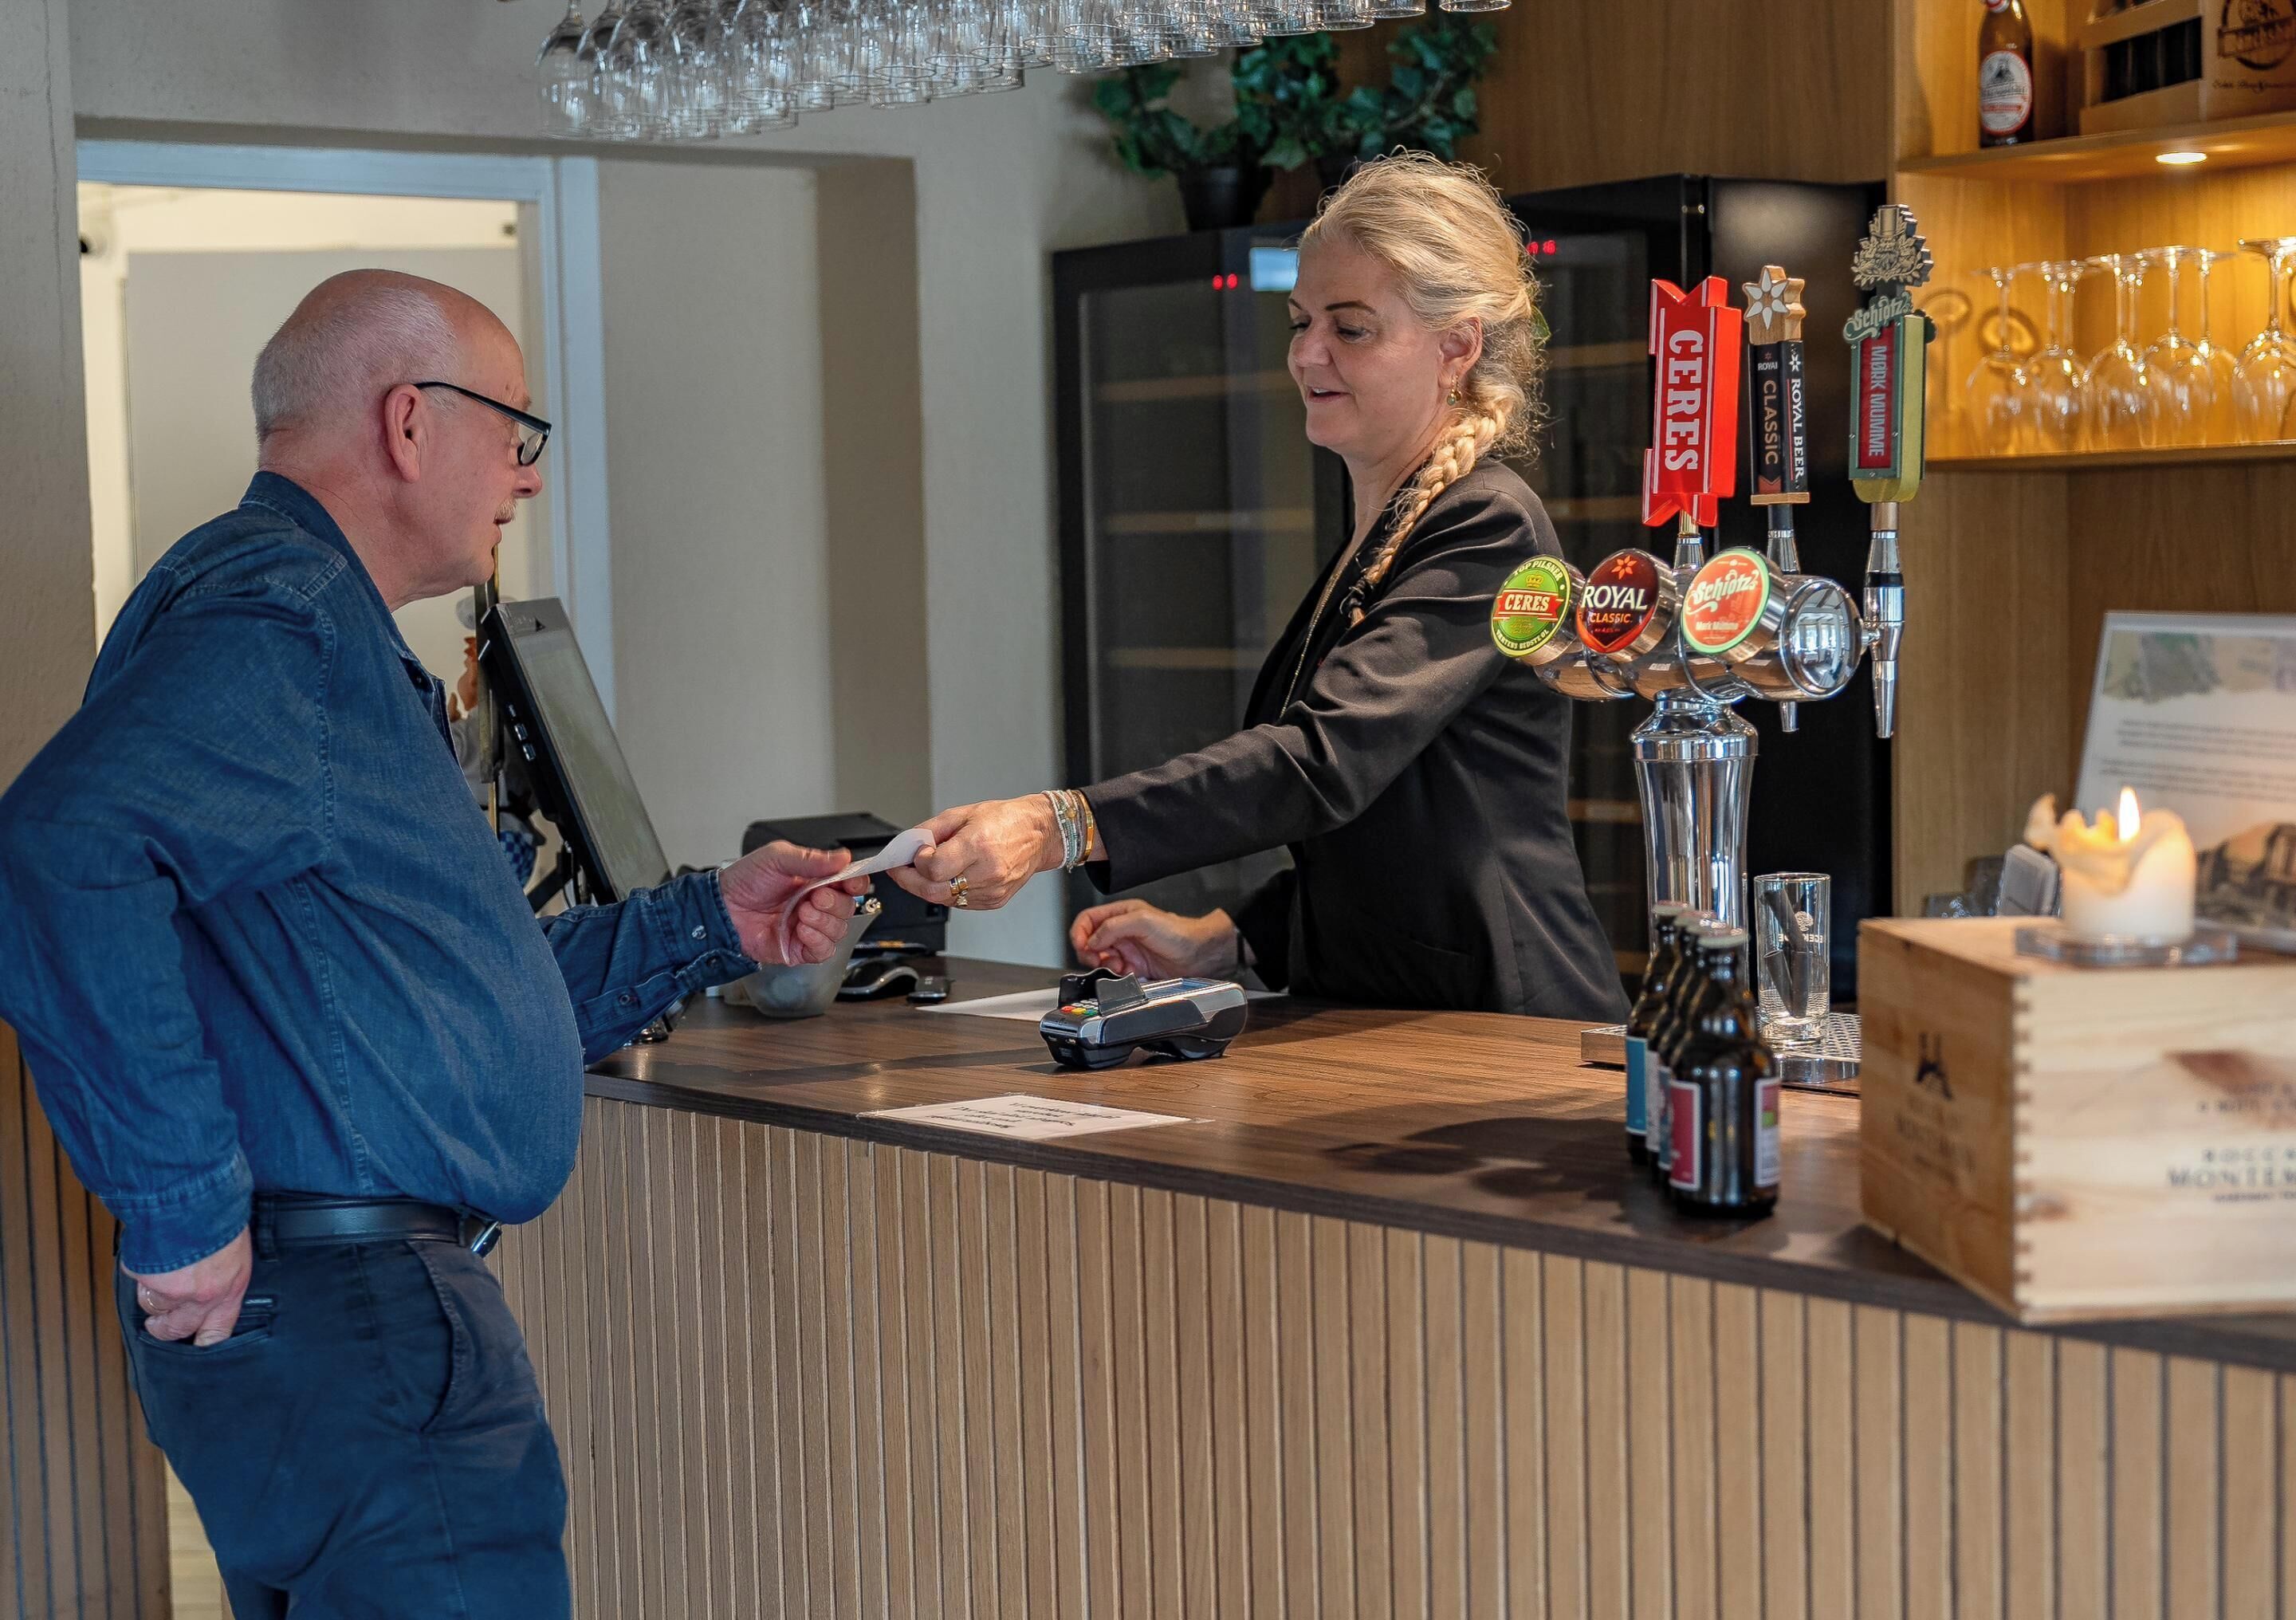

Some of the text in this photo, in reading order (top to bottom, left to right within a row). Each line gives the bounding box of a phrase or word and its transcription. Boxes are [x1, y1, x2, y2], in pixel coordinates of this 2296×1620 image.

[1665, 329, 1704, 470] CERES
[1763, 379, 1779, 465] CLASSIC
[1869, 345, 1887, 457] MØRK MUMME
[1791, 379, 1805, 480] ROYAL BEER
[1513, 560, 1563, 582] TOP PILSNER
[1581, 585, 1648, 610] ROYAL
[1504, 594, 1551, 612] CERES
[1590, 612, 1632, 623] CLASSIC
